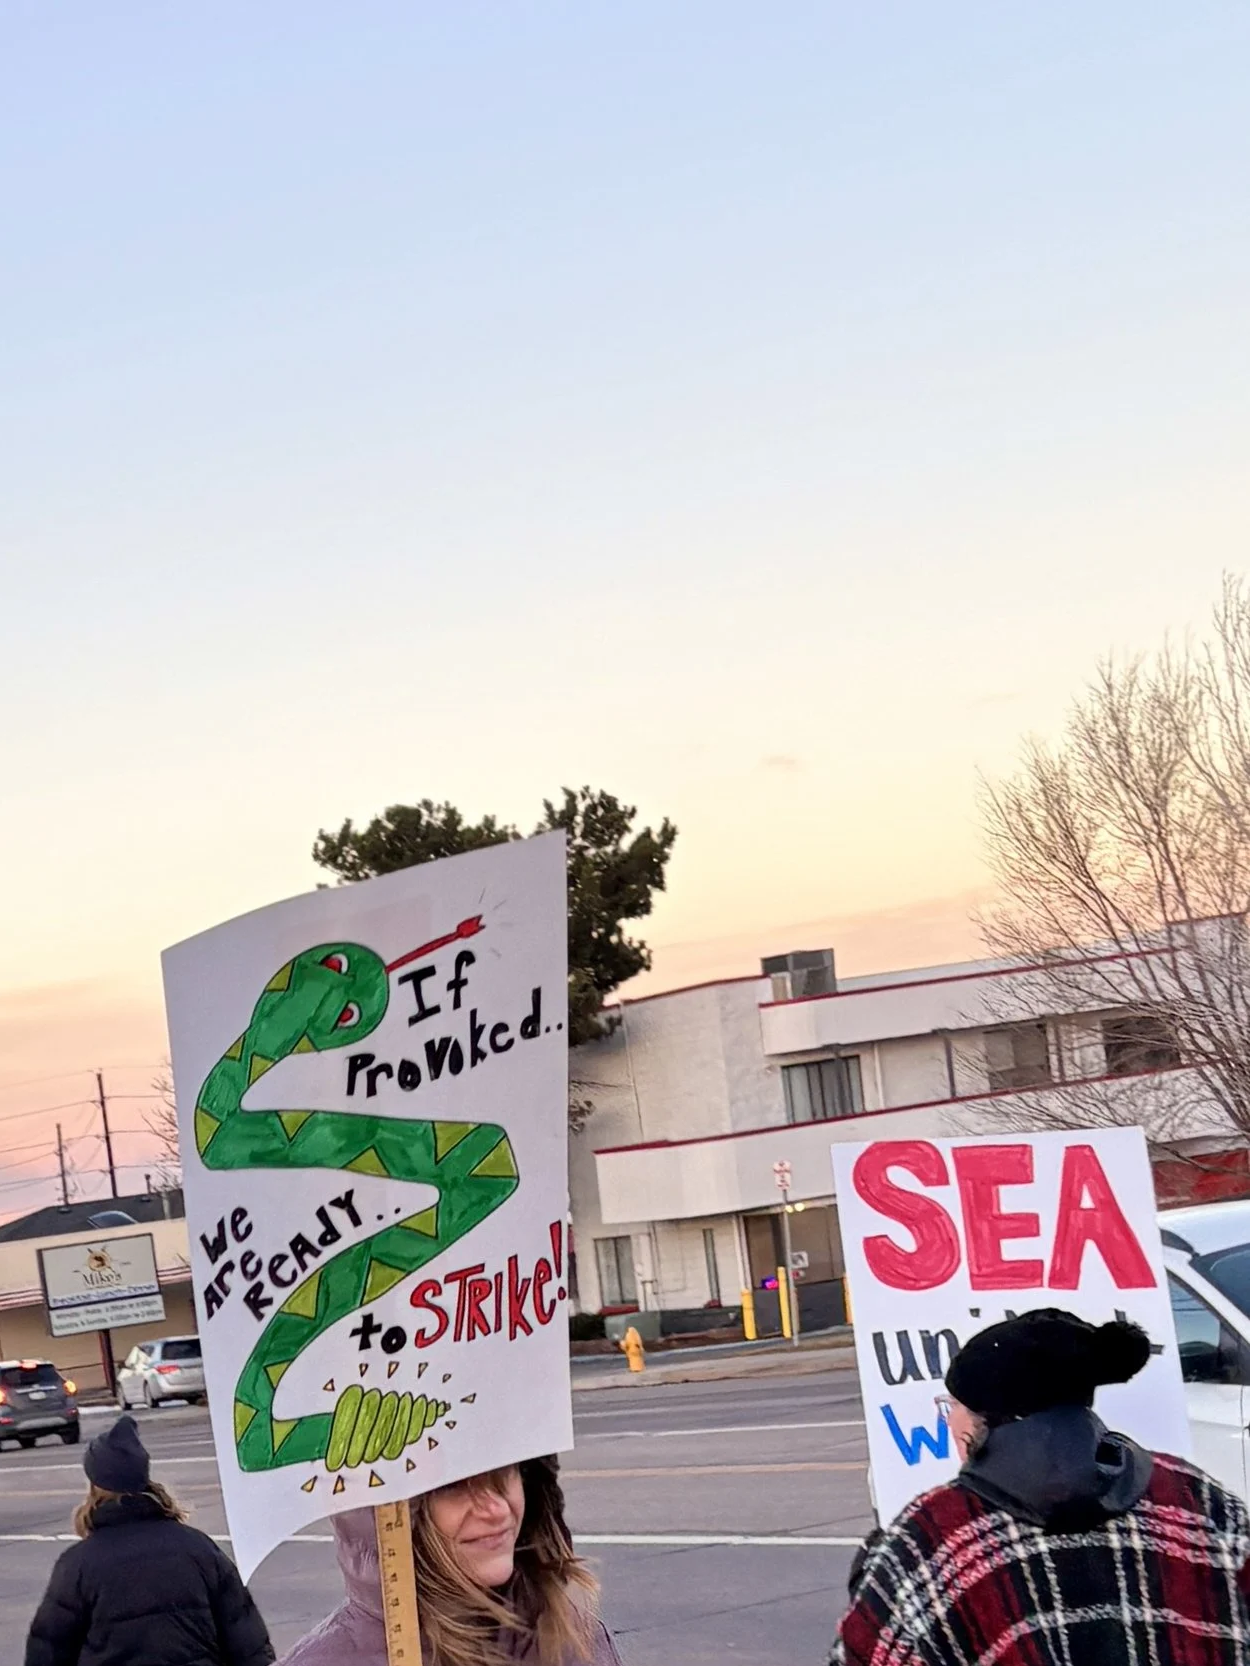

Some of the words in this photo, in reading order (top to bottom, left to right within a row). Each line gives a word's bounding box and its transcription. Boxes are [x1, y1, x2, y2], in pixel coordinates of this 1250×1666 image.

[398, 949, 477, 1028] If
[852, 1140, 1158, 1291] SEA
[350, 1312, 408, 1355] to
